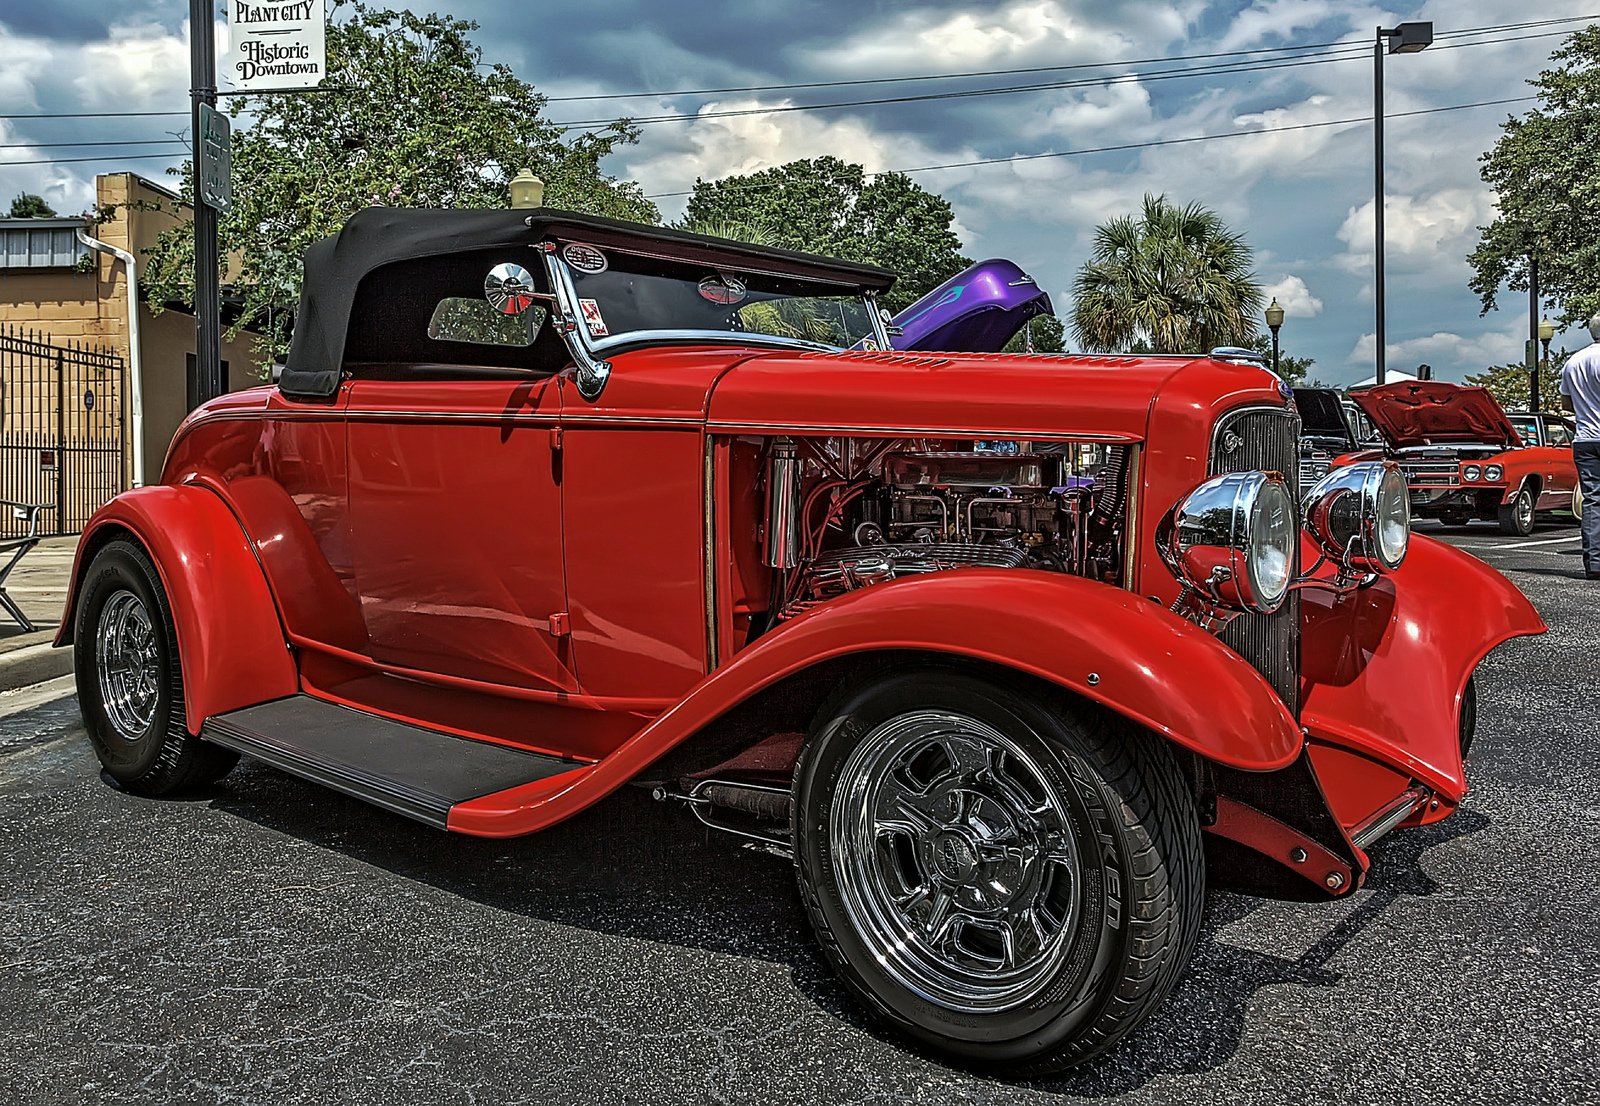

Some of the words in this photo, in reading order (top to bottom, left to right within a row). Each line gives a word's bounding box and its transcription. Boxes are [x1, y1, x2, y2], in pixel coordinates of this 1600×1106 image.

[235, 0, 279, 23] PLANT
[281, 0, 314, 20] CITY
[240, 41, 308, 65] Historic
[236, 61, 318, 80] Downtown
[1063, 750, 1121, 930] FALKEN
